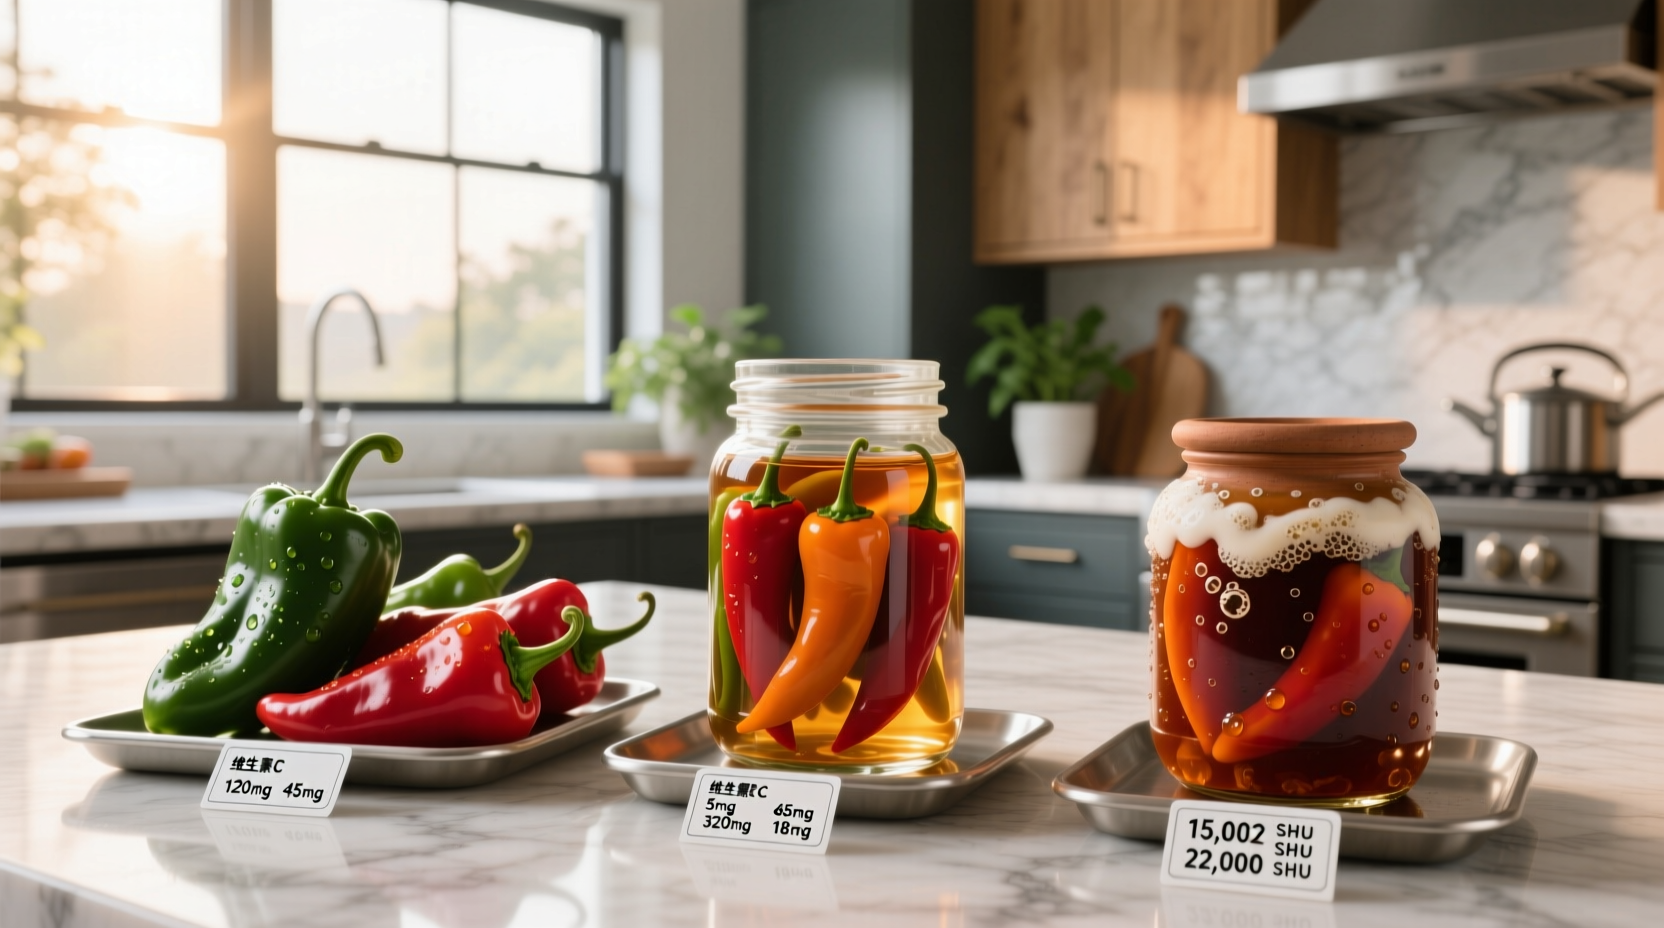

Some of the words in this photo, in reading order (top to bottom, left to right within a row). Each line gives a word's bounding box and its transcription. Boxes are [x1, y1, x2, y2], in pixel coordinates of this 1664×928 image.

[225, 779, 273, 800] 120mg
[282, 782, 325, 803] 45mg
[705, 798, 736, 816] 5mg
[702, 815, 752, 835] 320mg
[1188, 818, 1266, 846] 15,002
[1276, 823, 1314, 840] SHU
[1274, 841, 1313, 859] SHU
[1184, 847, 1264, 876] 22,000
[1272, 861, 1312, 880] SHU
